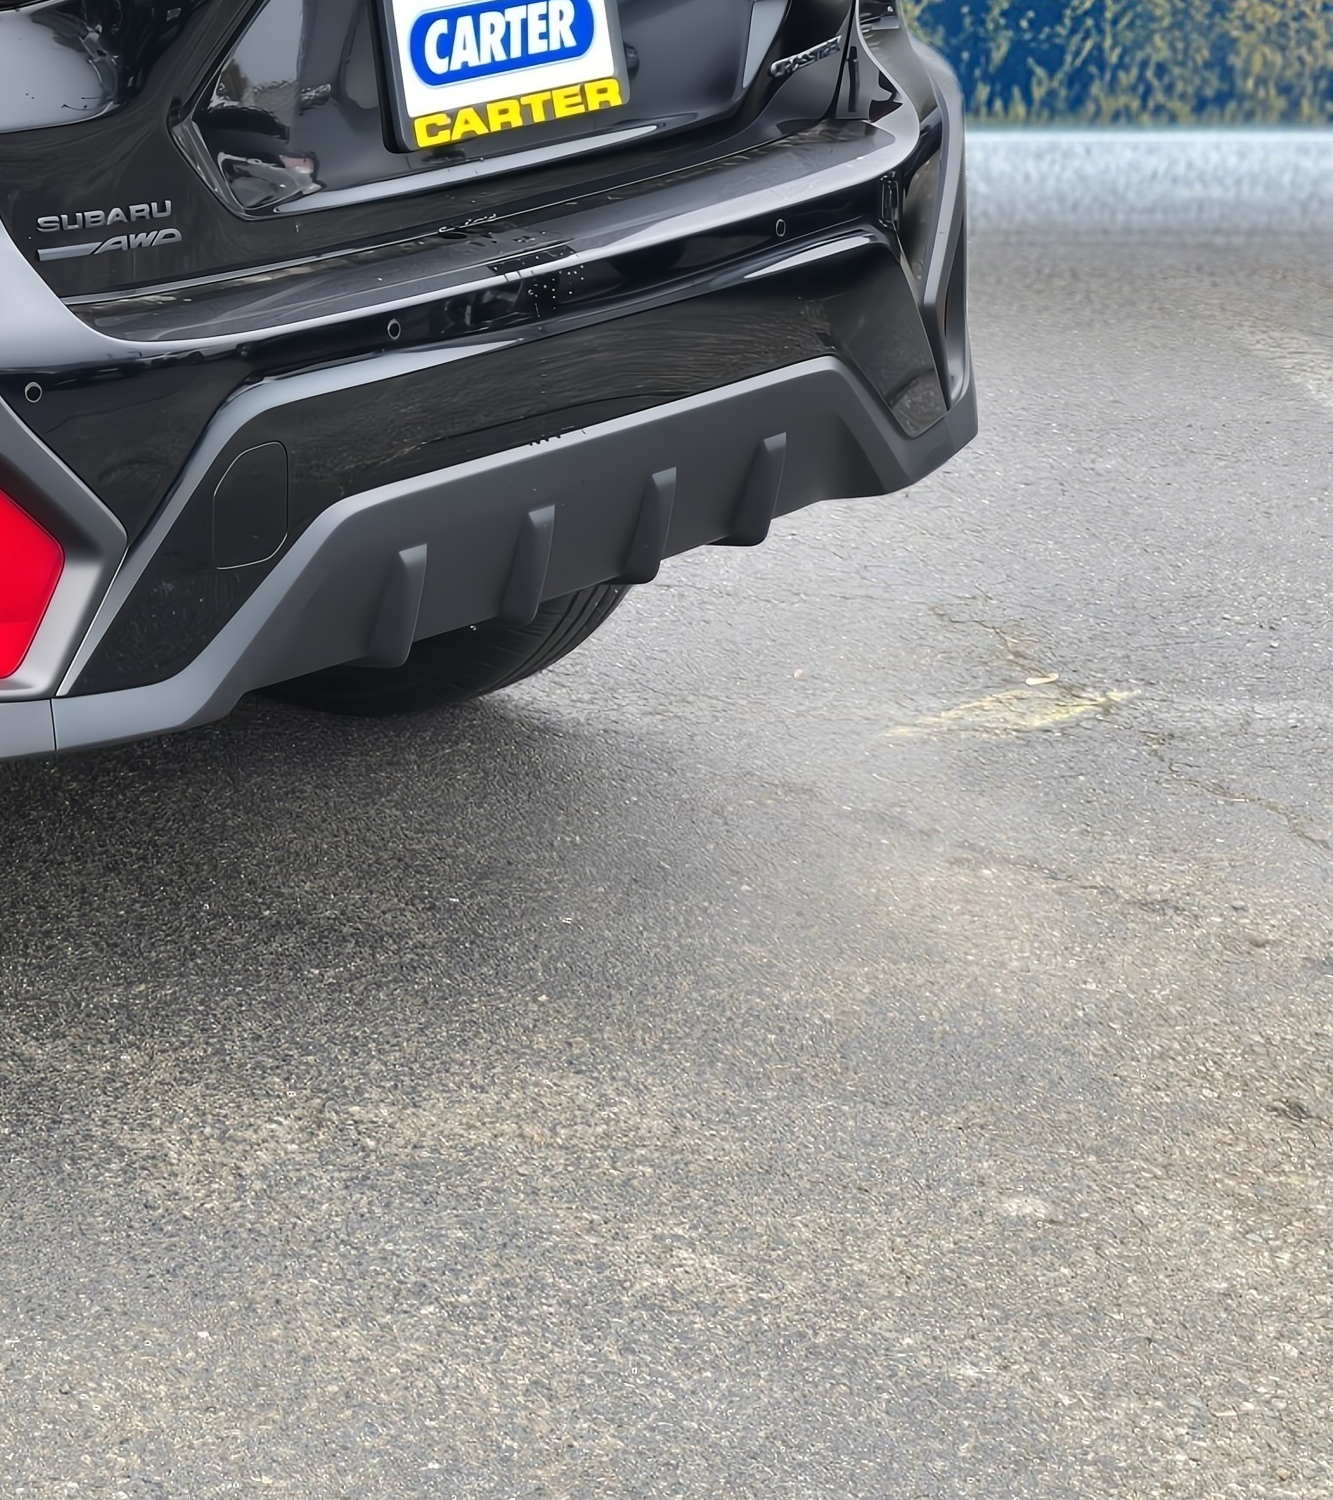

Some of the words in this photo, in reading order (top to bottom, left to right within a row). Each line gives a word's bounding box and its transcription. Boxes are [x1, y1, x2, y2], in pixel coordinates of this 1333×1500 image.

[413, 77, 623, 148] CARTER
[36, 200, 173, 232] SUBARU
[94, 228, 183, 254] AWD
